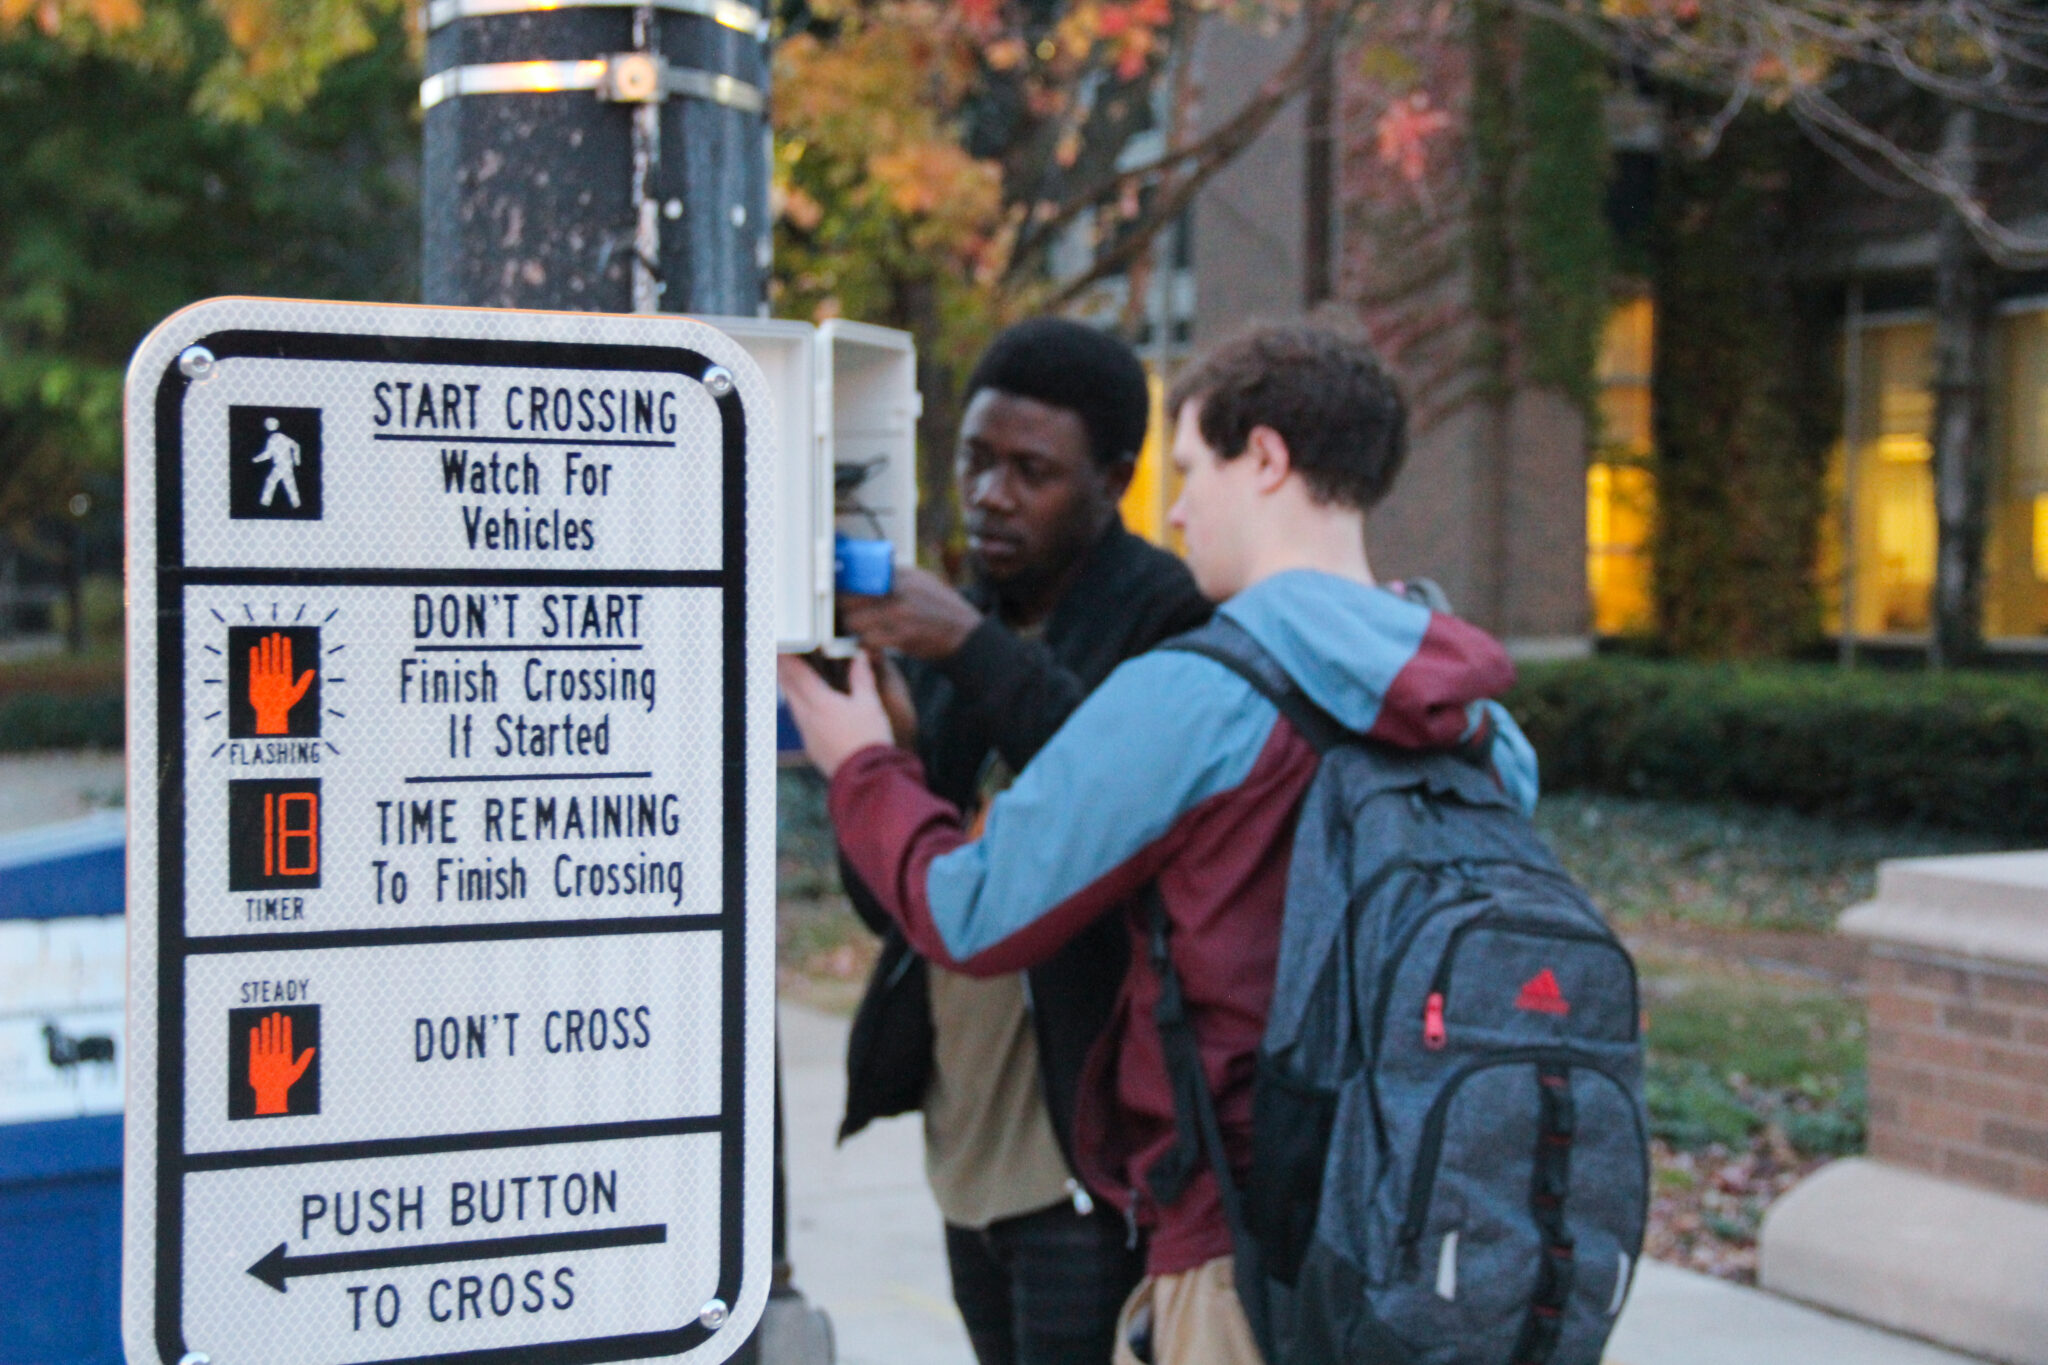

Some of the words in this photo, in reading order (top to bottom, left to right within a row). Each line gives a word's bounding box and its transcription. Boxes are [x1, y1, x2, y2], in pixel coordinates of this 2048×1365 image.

[374, 382, 480, 429] START
[506, 386, 676, 434] CROSSING
[441, 449, 539, 495] Watch
[566, 452, 612, 496] For
[462, 506, 594, 551] Vehicles
[414, 594, 519, 638] DON'T
[542, 594, 643, 638] START
[401, 659, 497, 703] Finish
[525, 658, 655, 712] Crossing
[230, 742, 320, 765] FLASHING
[449, 715, 472, 759] If
[495, 714, 609, 757] Started
[265, 793, 317, 875] 18
[377, 799, 456, 845] TIME
[485, 794, 679, 841] REMAINING
[372, 861, 407, 904] To
[437, 857, 526, 901] Finish
[555, 854, 682, 906] Crossing
[246, 896, 304, 922] TIMER
[241, 979, 309, 1003] STEADY
[416, 1013, 519, 1062] DON'T
[545, 1006, 649, 1053] CROSS
[302, 1186, 423, 1239] PUSH
[451, 1170, 616, 1226] BUTTON
[347, 1284, 400, 1331] TO
[429, 1267, 573, 1322] CROSS
